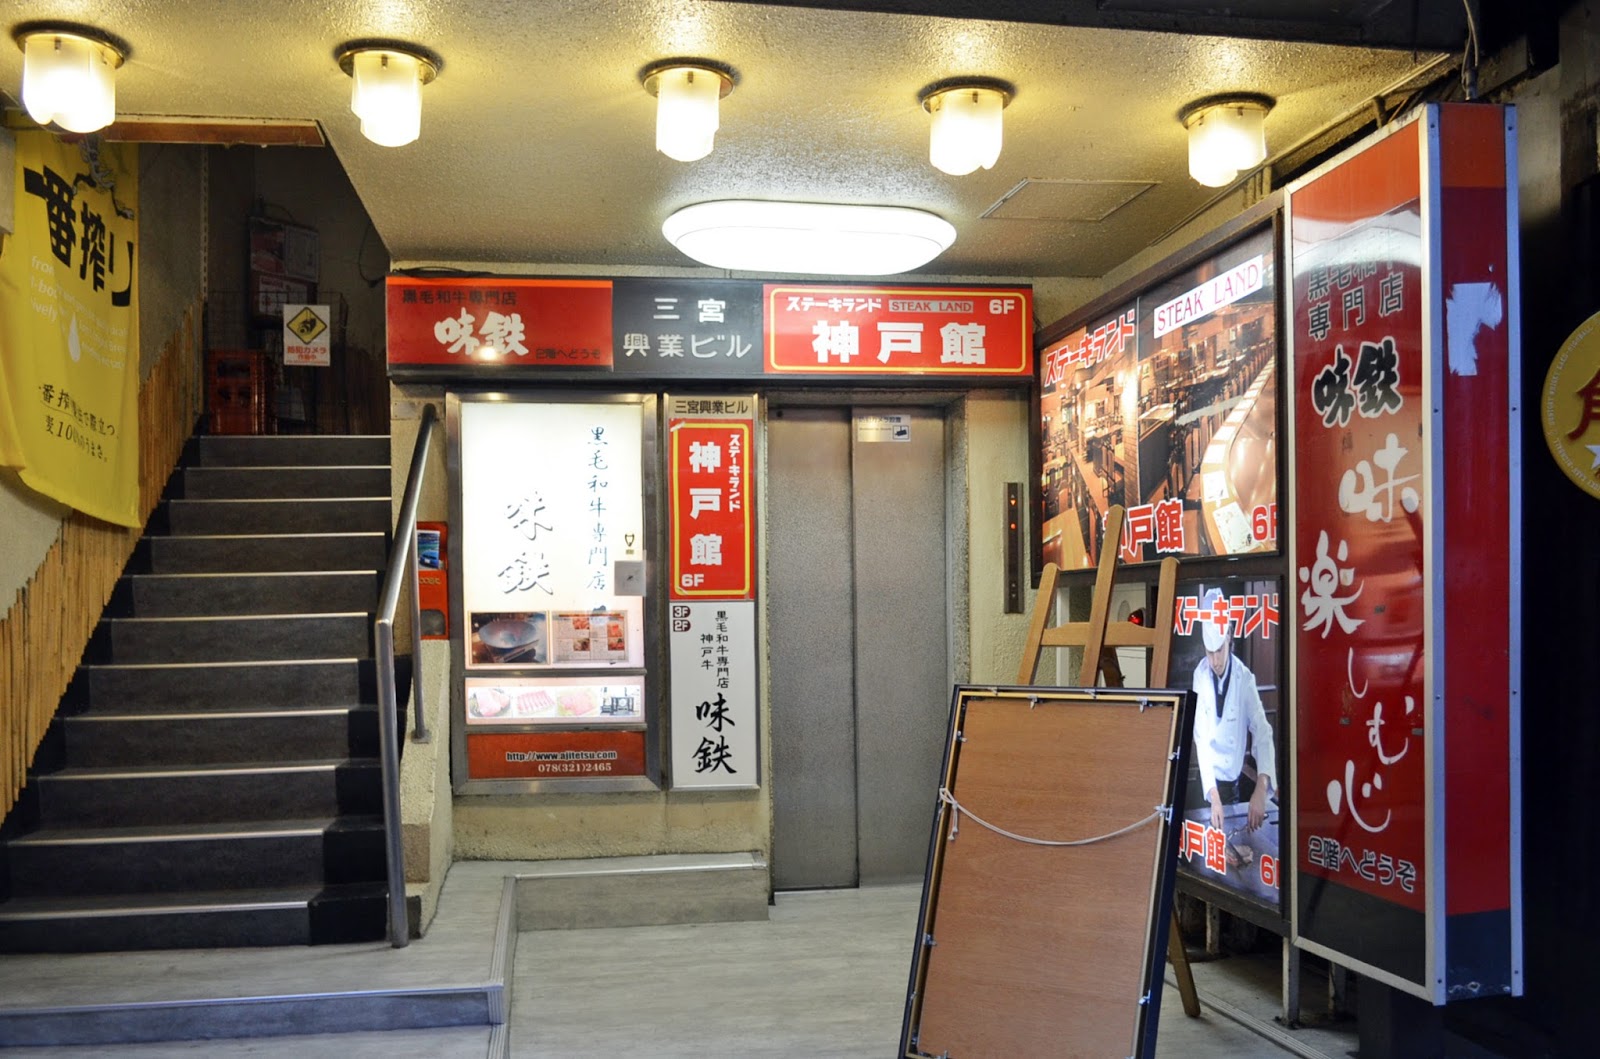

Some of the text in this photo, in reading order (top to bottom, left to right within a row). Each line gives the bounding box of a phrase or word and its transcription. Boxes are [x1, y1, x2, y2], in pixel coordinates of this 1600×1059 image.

[24, 165, 134, 307] 一番搾り
[402, 289, 517, 306] 黒毛和牛専門店
[653, 298, 726, 323] 三宮
[786, 296, 1015, 315] ステーキランド STEAK LAND 6F
[1157, 263, 1260, 332] STEAK LAND
[1308, 271, 1403, 342] 専門店
[434, 307, 529, 356] 味鉄
[535, 348, 601, 360] 2階へどうぞ
[623, 333, 753, 358] 興業ビル
[812, 320, 986, 365] 神戸館
[1044, 308, 1136, 388] ステーキランド
[1312, 336, 1403, 428] 味鉄
[675, 400, 748, 414] 三宮興業ビル
[728, 434, 741, 513] ステーキランド
[587, 426, 609, 592] 黒毛和牛専門店
[689, 441, 722, 566] 神戸館
[682, 573, 704, 587] 6F
[673, 606, 690, 618] 3F
[673, 620, 690, 632] 2F
[700, 633, 714, 671] 神戸牛
[715, 610, 730, 689] 黒毛和牛専門店
[692, 692, 737, 774] 味鉄
[506, 751, 618, 763] http://www.ajitetsu.com
[538, 763, 612, 773] 078(321)2465
[1308, 835, 1416, 893] 2階へどうぞ
